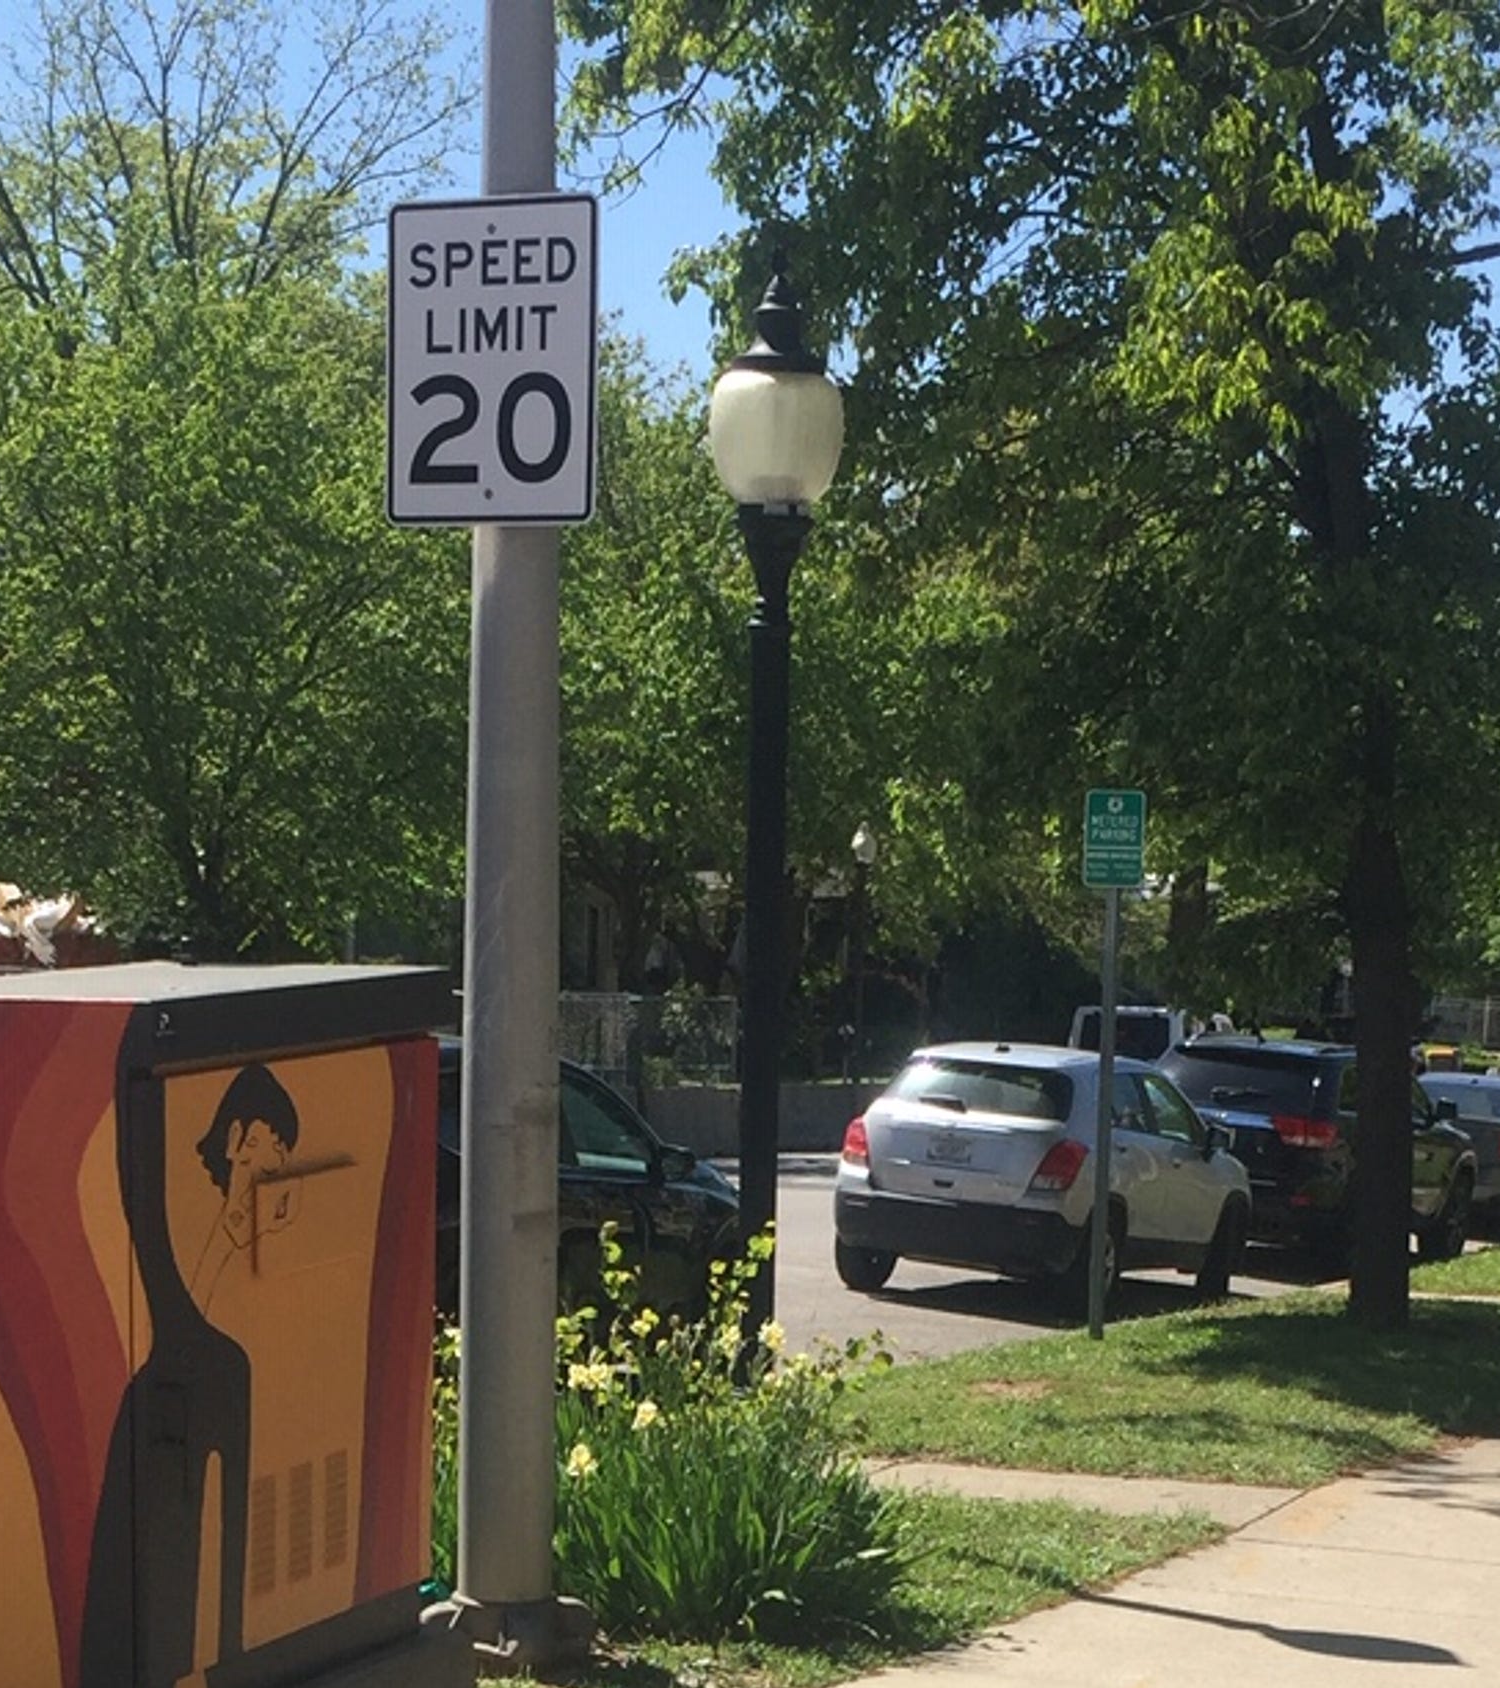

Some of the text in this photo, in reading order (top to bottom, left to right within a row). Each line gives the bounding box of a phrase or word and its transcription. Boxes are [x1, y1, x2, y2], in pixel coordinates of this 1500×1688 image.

[410, 237, 577, 288] SPEED
[426, 305, 557, 353] LIMIT
[410, 371, 572, 485] 20
[1091, 815, 1139, 828] METERED
